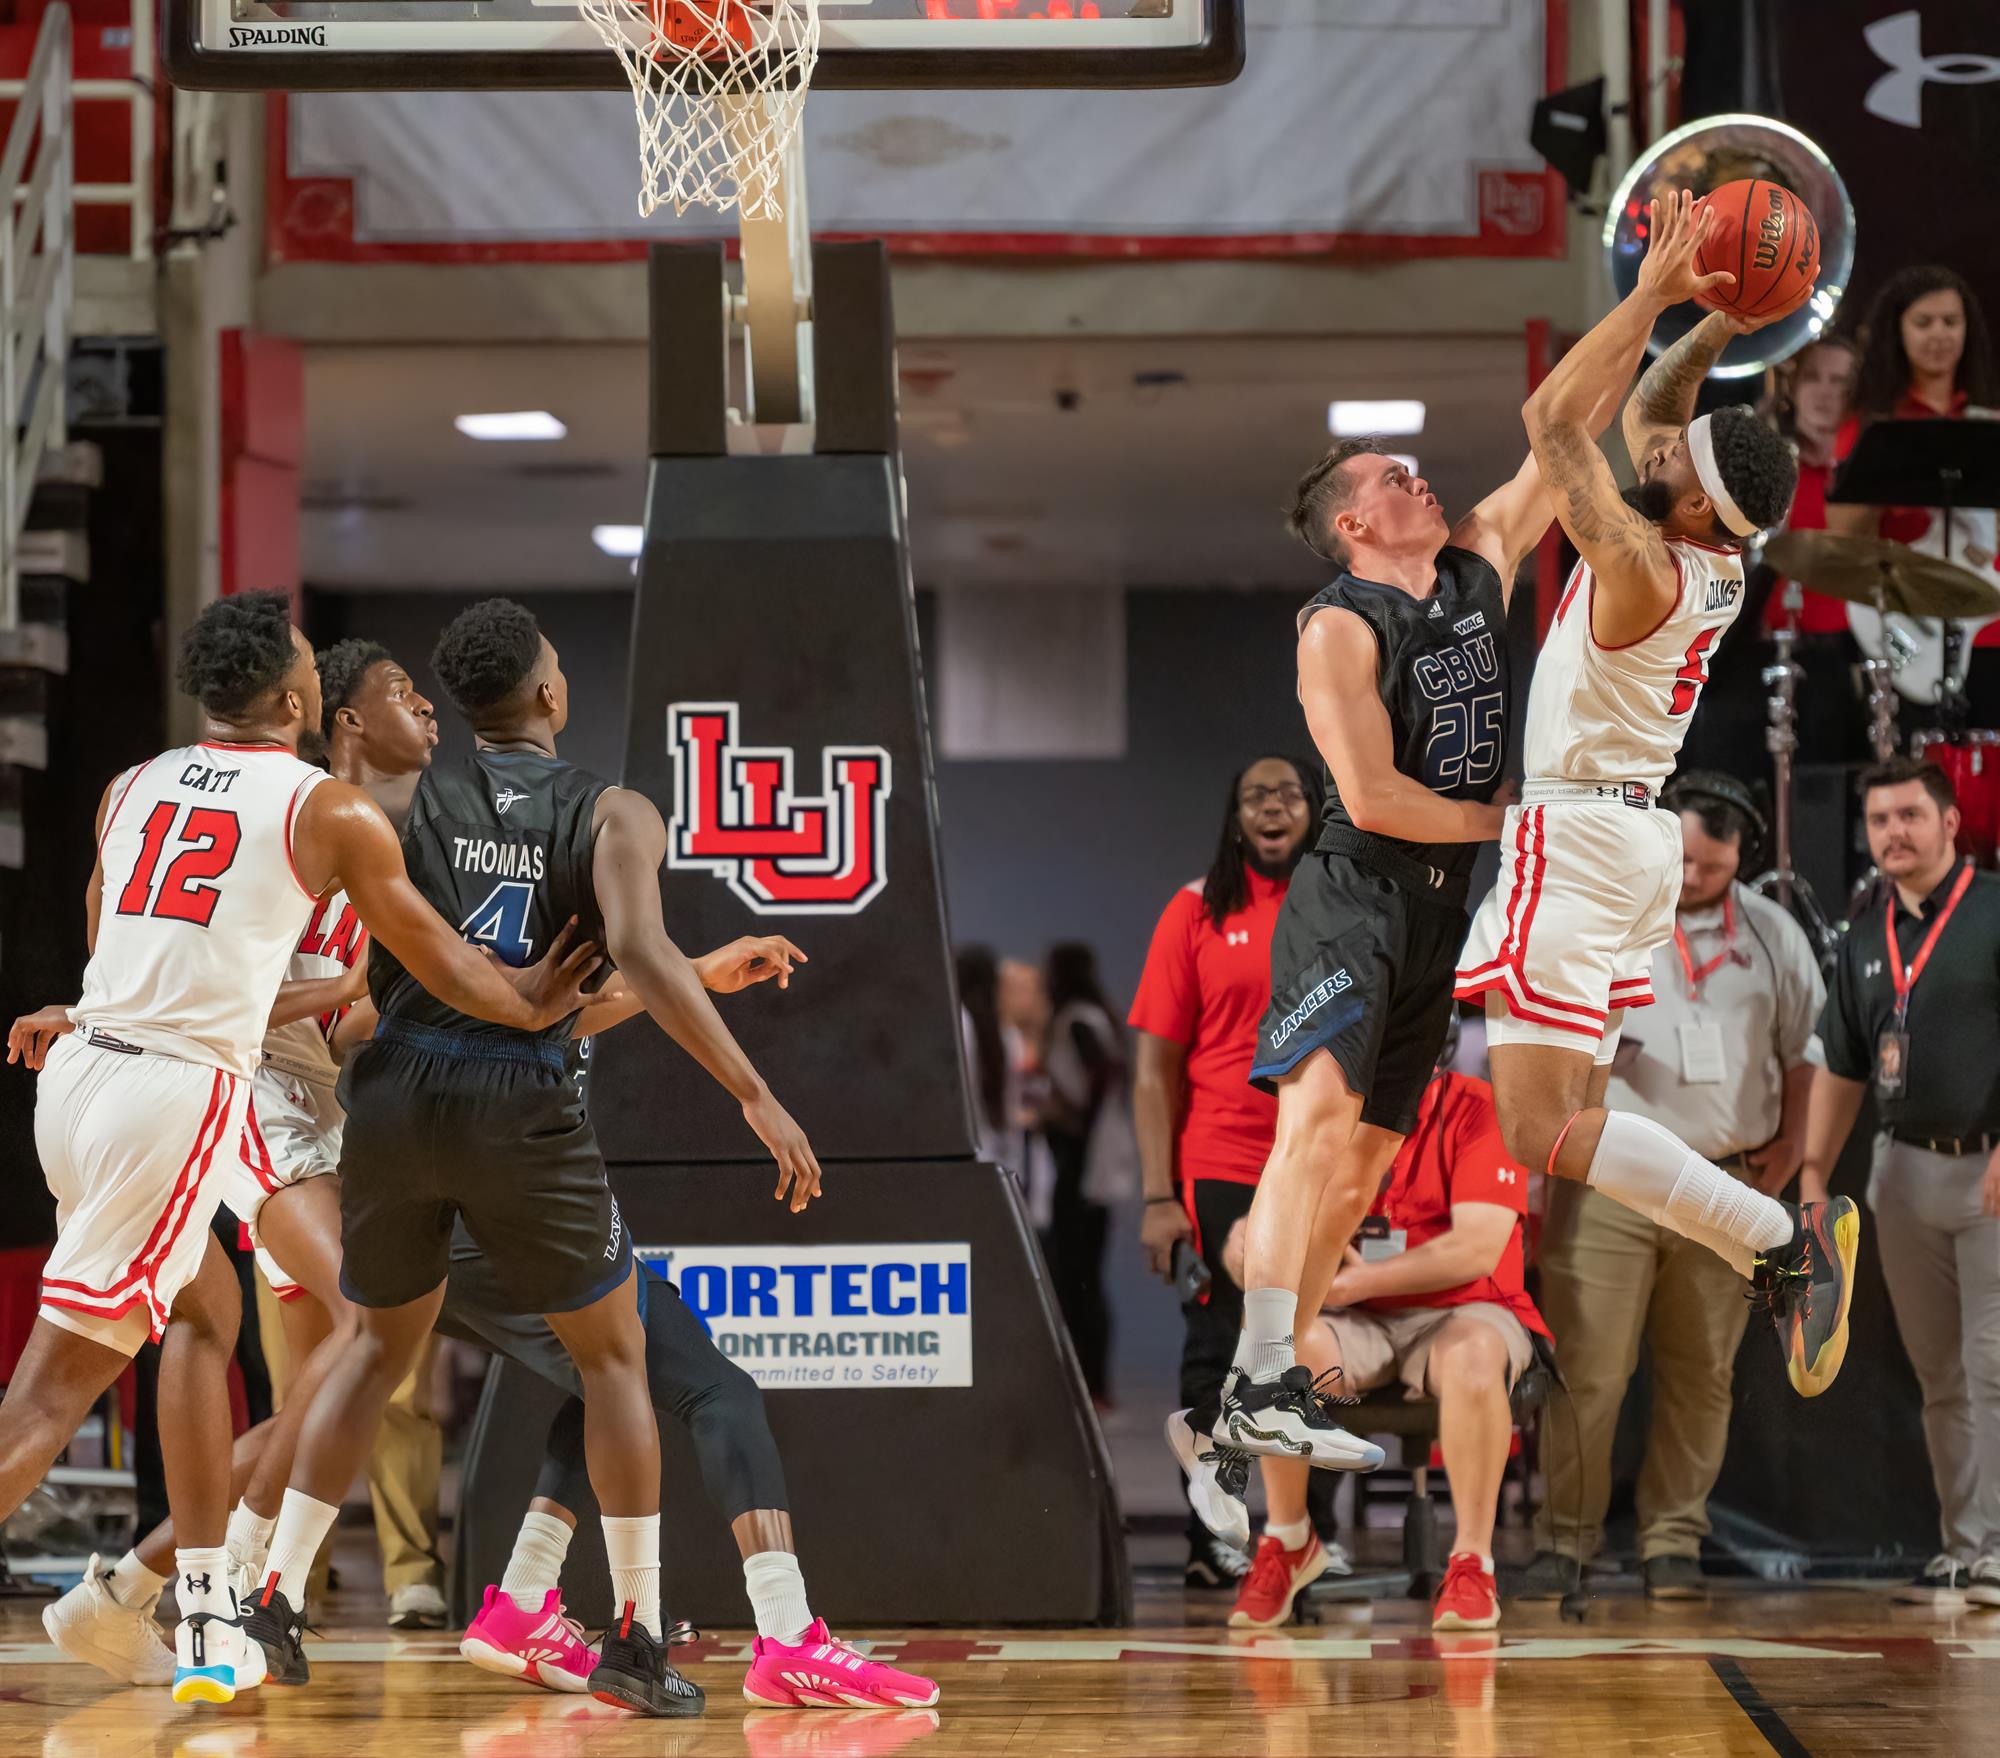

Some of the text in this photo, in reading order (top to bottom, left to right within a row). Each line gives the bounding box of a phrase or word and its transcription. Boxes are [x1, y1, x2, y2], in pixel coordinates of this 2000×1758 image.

[229, 25, 325, 48] SPALDING
[1753, 189, 1784, 270] Wilson
[1455, 612, 1485, 635] WAC
[1705, 580, 1743, 612] ADAMS
[1414, 632, 1498, 700] CBU
[1426, 692, 1502, 791] 25
[179, 764, 241, 793] CATT
[667, 702, 892, 915] LU
[116, 800, 242, 928] 12
[453, 837, 544, 880] THOMAS
[459, 881, 535, 968] 4
[1270, 968, 1353, 1049] LANCERS
[645, 1260, 967, 1320] ORTECH
[718, 1331, 940, 1358] ONTRACTING
[750, 1364, 939, 1385] mmitted to Safety
